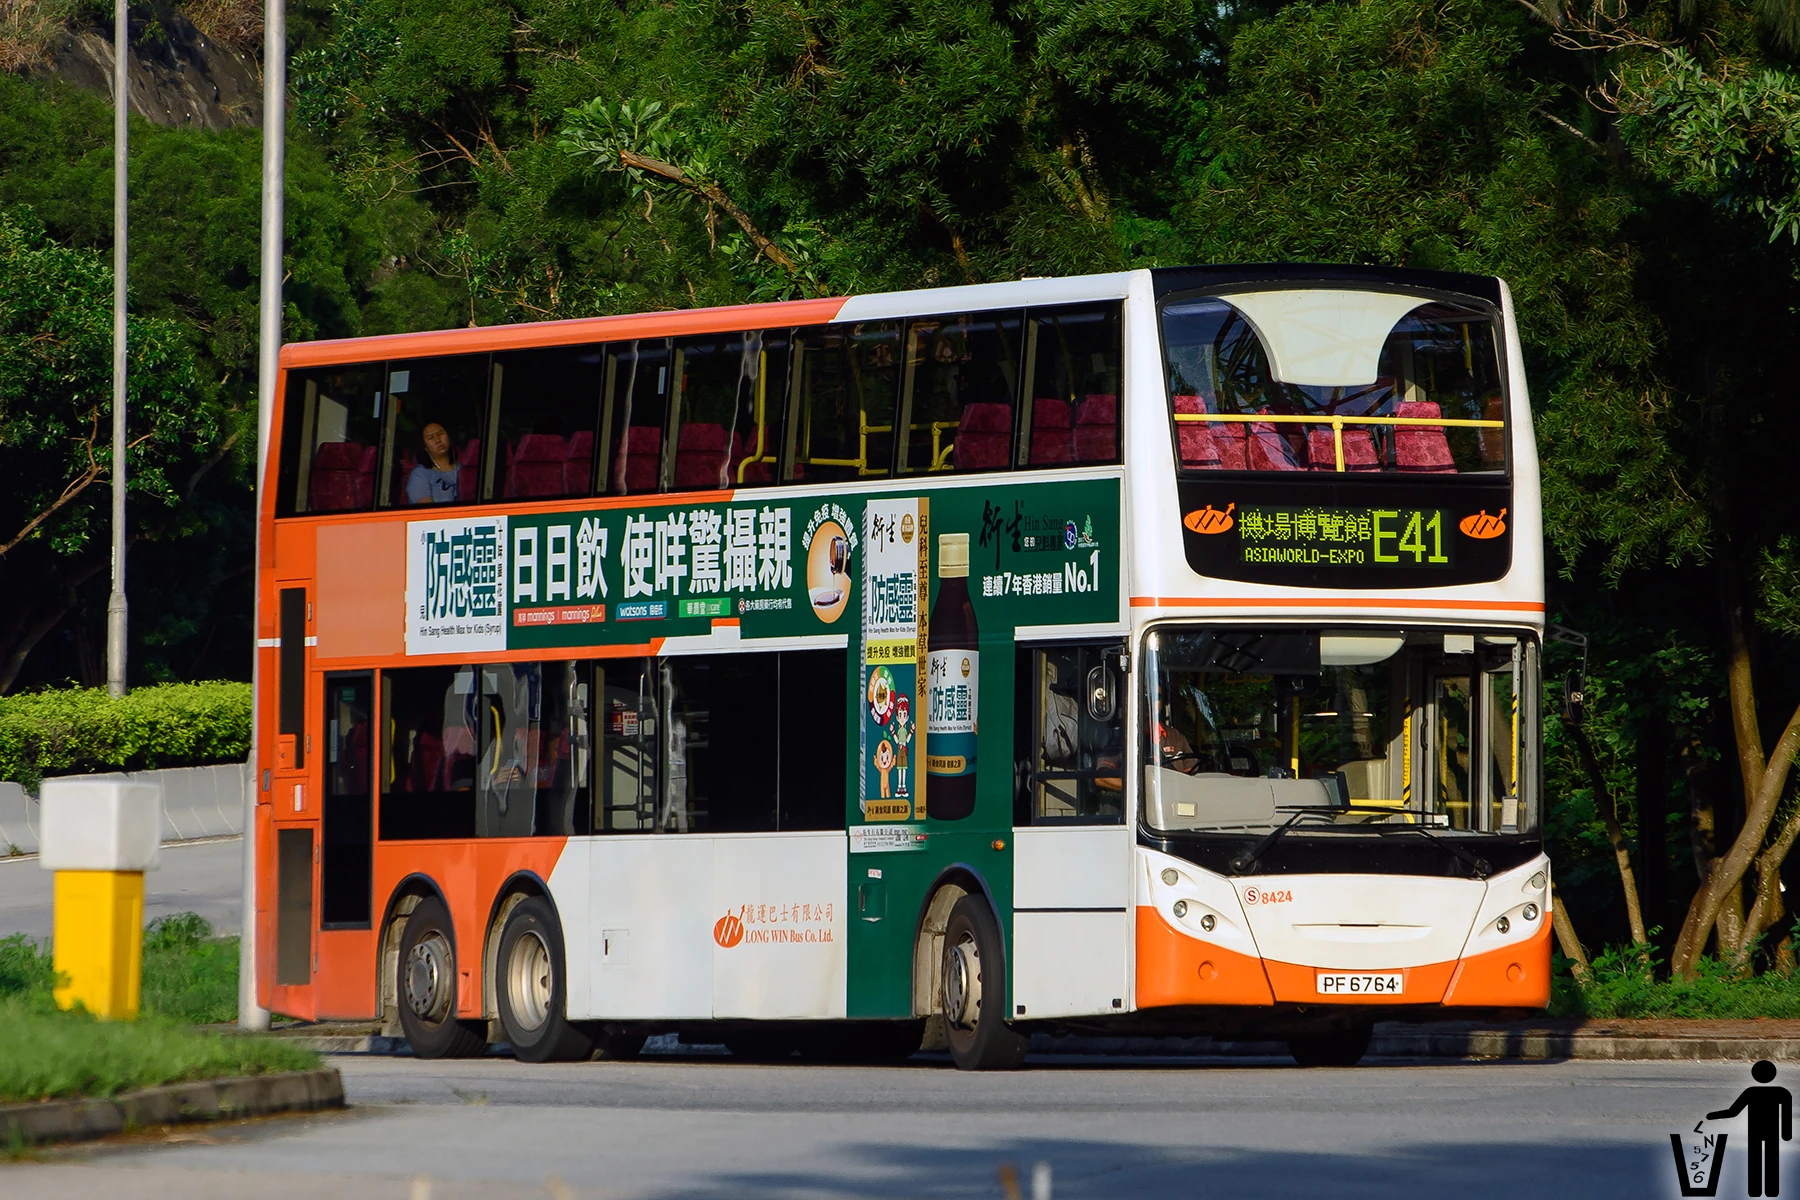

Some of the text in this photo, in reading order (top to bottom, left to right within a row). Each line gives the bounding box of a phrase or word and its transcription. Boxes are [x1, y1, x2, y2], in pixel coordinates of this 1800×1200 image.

[1024, 514, 1063, 534] Hin Sang
[1238, 509, 1372, 543] 機場博覽館
[1372, 510, 1448, 563] E41
[513, 517, 608, 603] 日日飲
[621, 506, 793, 598] 使咩驚攝親
[1245, 547, 1365, 564] ASIAWORLD-EXPO
[426, 526, 497, 621] 防感靈
[1065, 550, 1100, 593] No.1
[871, 572, 913, 625] 防感靈
[527, 609, 555, 625] mannings
[561, 608, 590, 623] mannings
[619, 605, 647, 617] watsons
[932, 684, 968, 722] 防感靈
[1261, 890, 1293, 904] 8424
[746, 903, 833, 924] 龍運巴士有限公司
[745, 928, 834, 944] LONG WIN Bus Co. Ltd.
